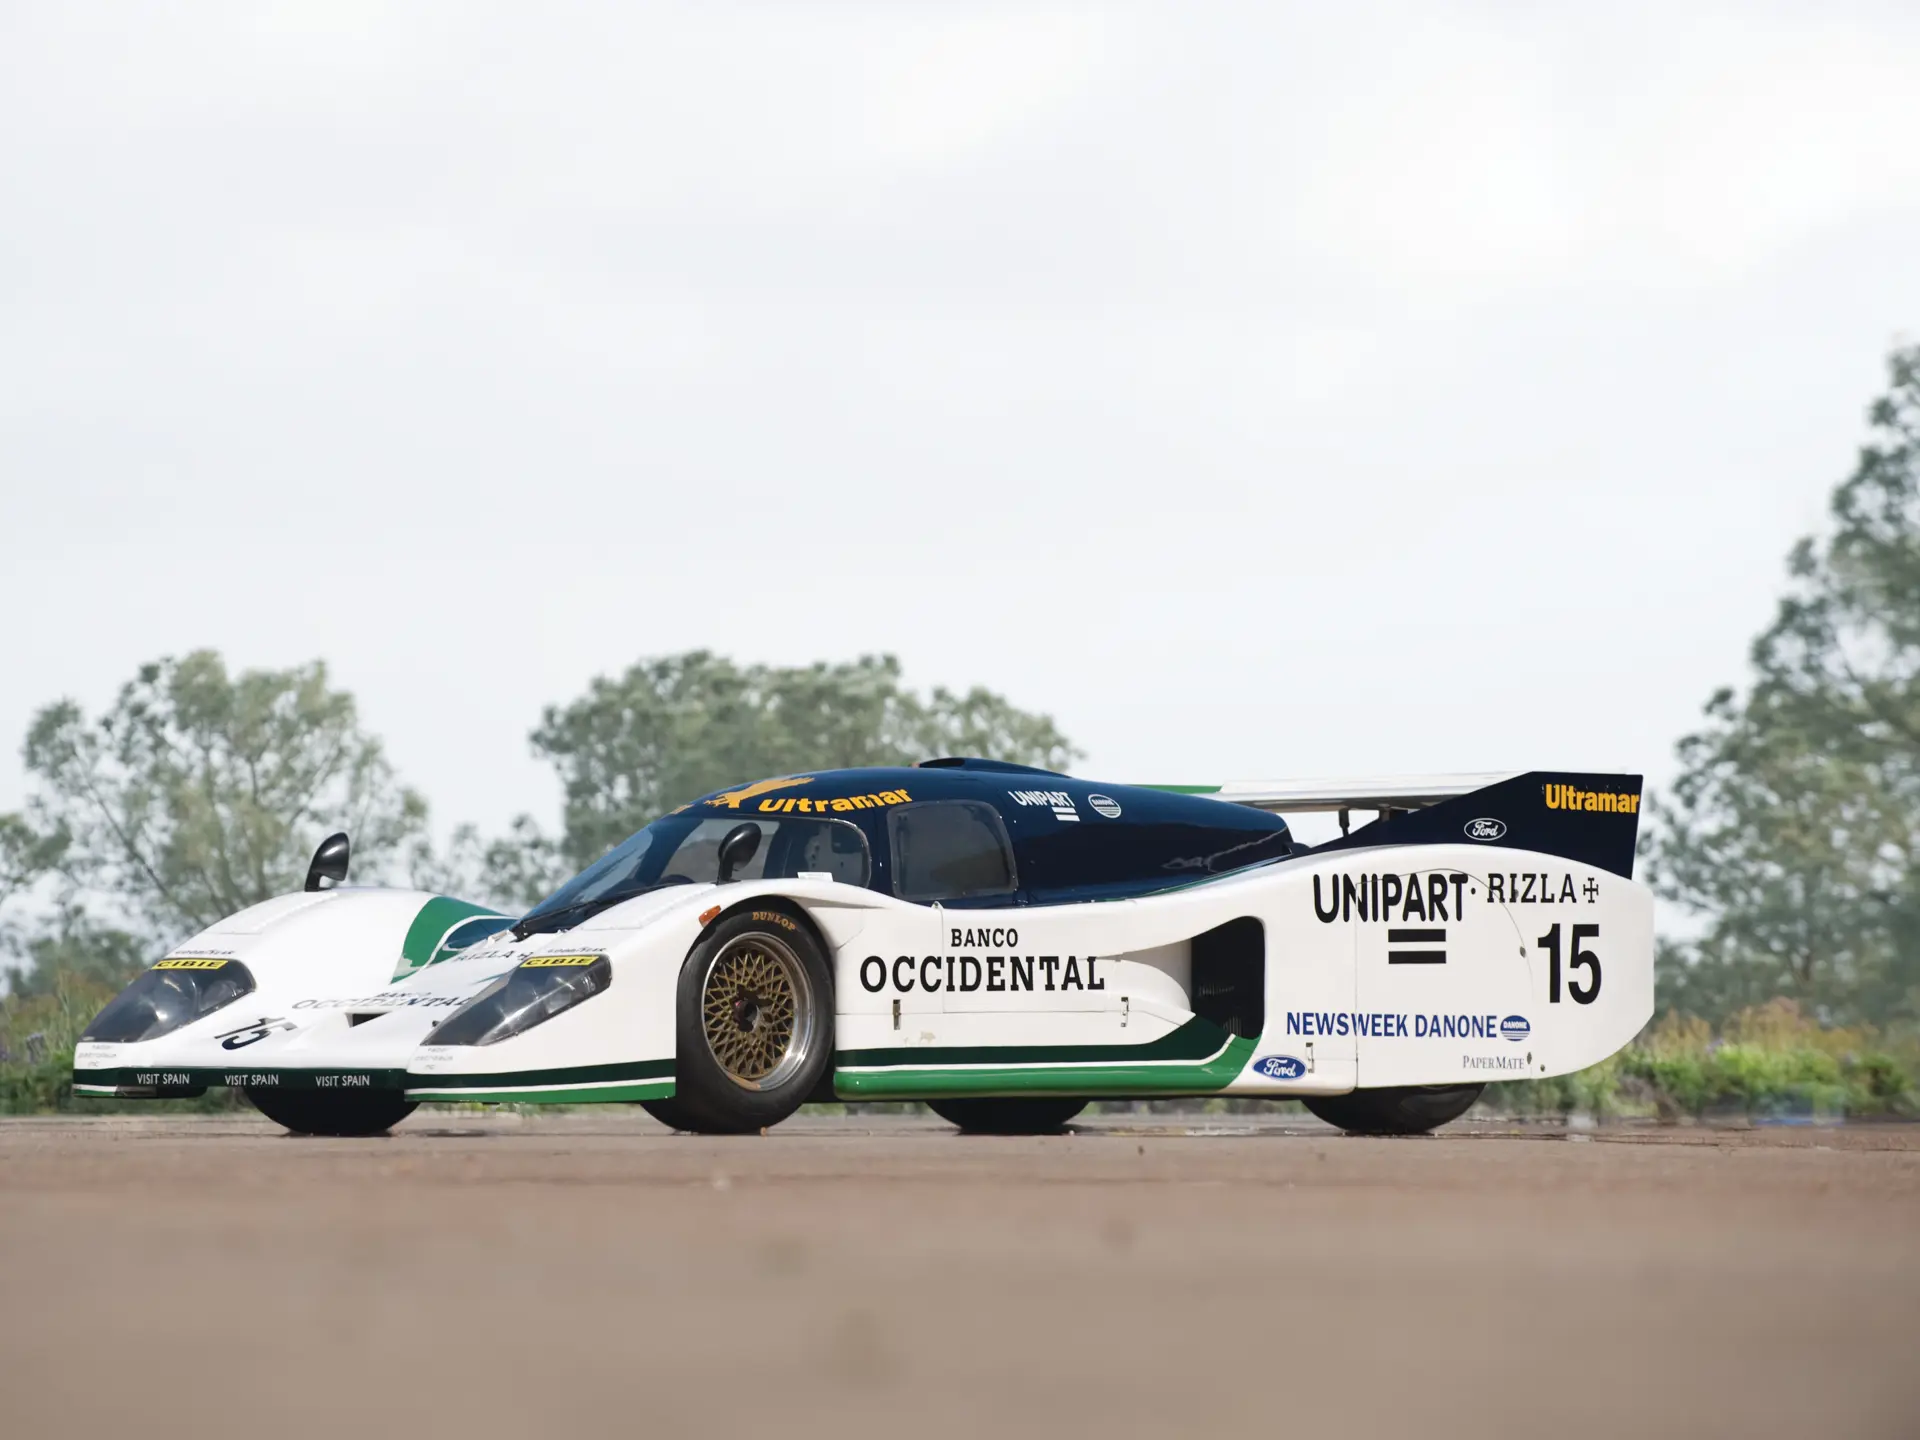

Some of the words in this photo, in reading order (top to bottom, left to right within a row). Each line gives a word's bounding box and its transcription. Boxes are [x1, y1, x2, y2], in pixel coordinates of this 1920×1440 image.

[758, 788, 913, 813] Ultramar
[1008, 791, 1075, 807] UNIPART
[1545, 784, 1639, 813] Ultramar
[1472, 820, 1499, 837] Ford
[1313, 873, 1469, 923] UNIPART
[1487, 873, 1577, 904] RIZLA
[752, 911, 797, 931] DUNLOP
[951, 928, 1019, 948] BANCO
[157, 960, 222, 968] CIBIE
[525, 957, 594, 966] CIBIE
[1537, 922, 1602, 1005] 15
[860, 956, 1105, 993] OCCIDENTAL
[213, 1017, 298, 1050] 15
[1286, 1012, 1409, 1038] NEWSWEEK
[1415, 1014, 1498, 1038] DANONE
[1263, 1058, 1297, 1078] Ford
[137, 1074, 160, 1085] VISIT
[162, 1073, 190, 1085] SPAIN
[225, 1075, 249, 1086] VISIT
[251, 1074, 279, 1085] SPAIN
[315, 1076, 339, 1087] VISIT
[342, 1075, 371, 1086] SPAIN
